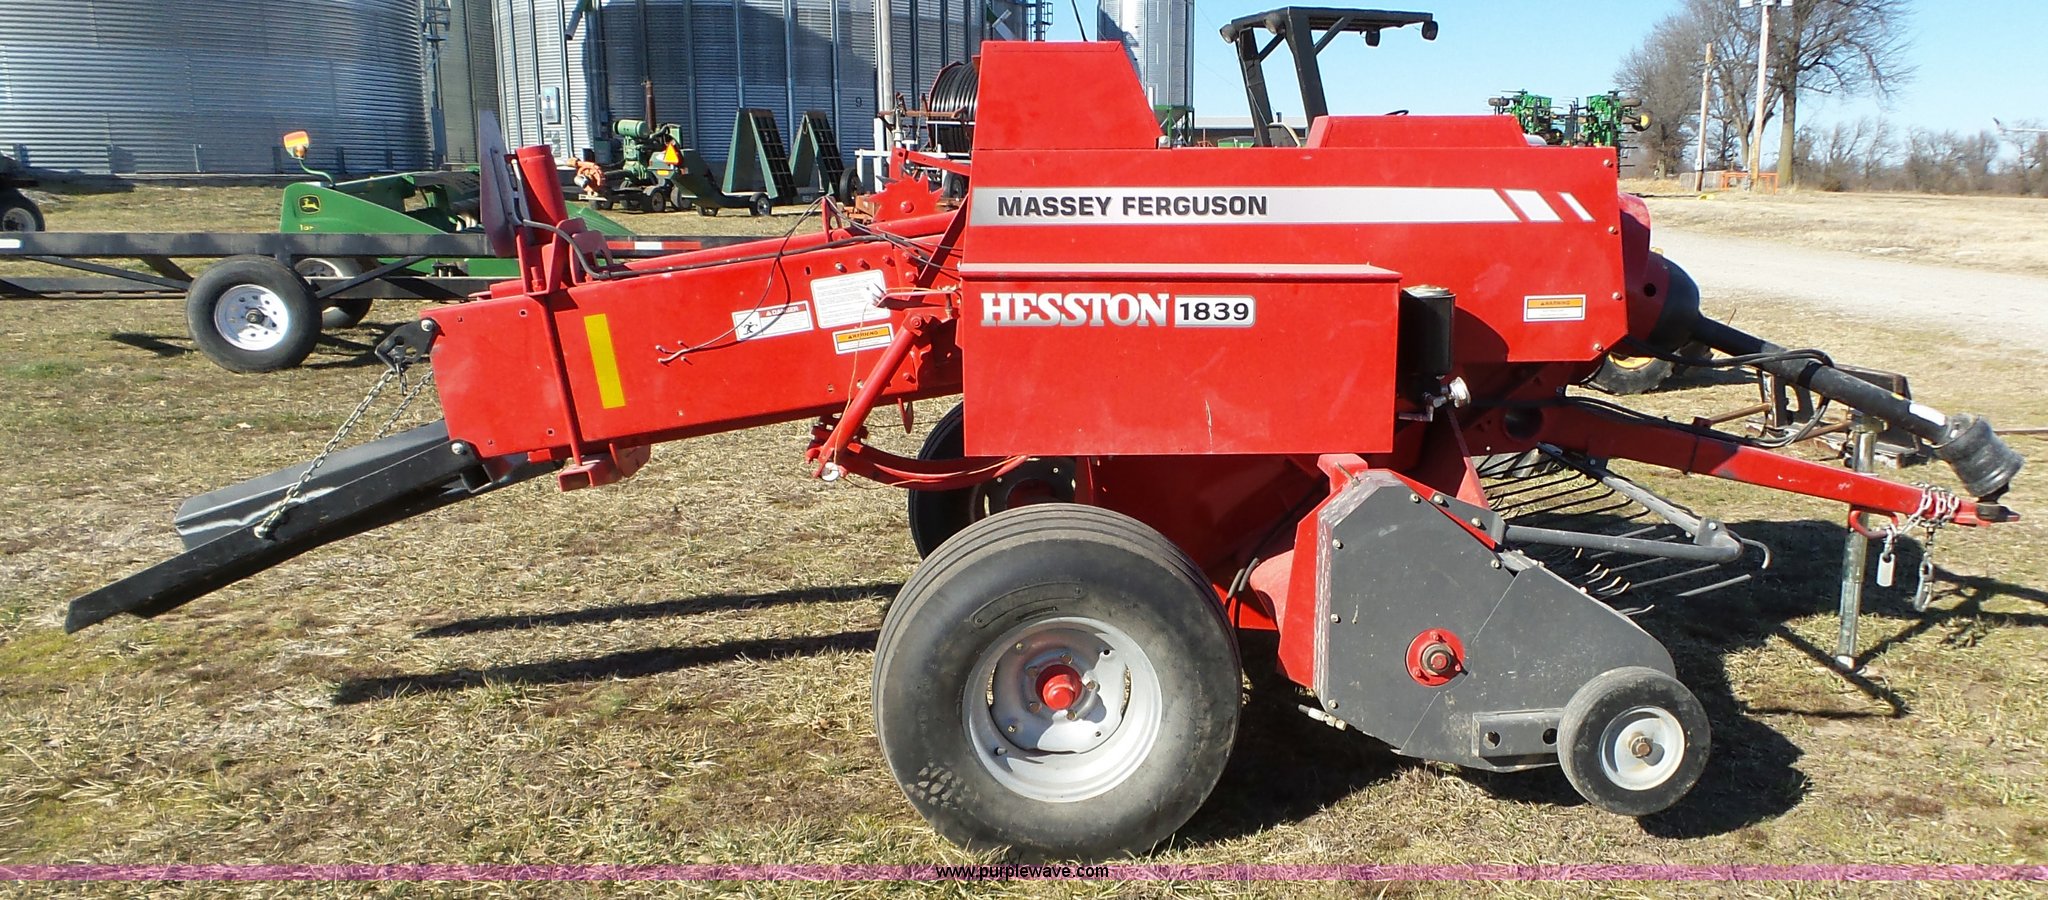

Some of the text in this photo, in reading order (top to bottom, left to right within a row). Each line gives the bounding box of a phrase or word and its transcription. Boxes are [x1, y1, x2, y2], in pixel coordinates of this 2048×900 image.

[998, 196, 1268, 216] MASSEY FERGUSON
[980, 293, 1250, 327] HESSTON 1839
